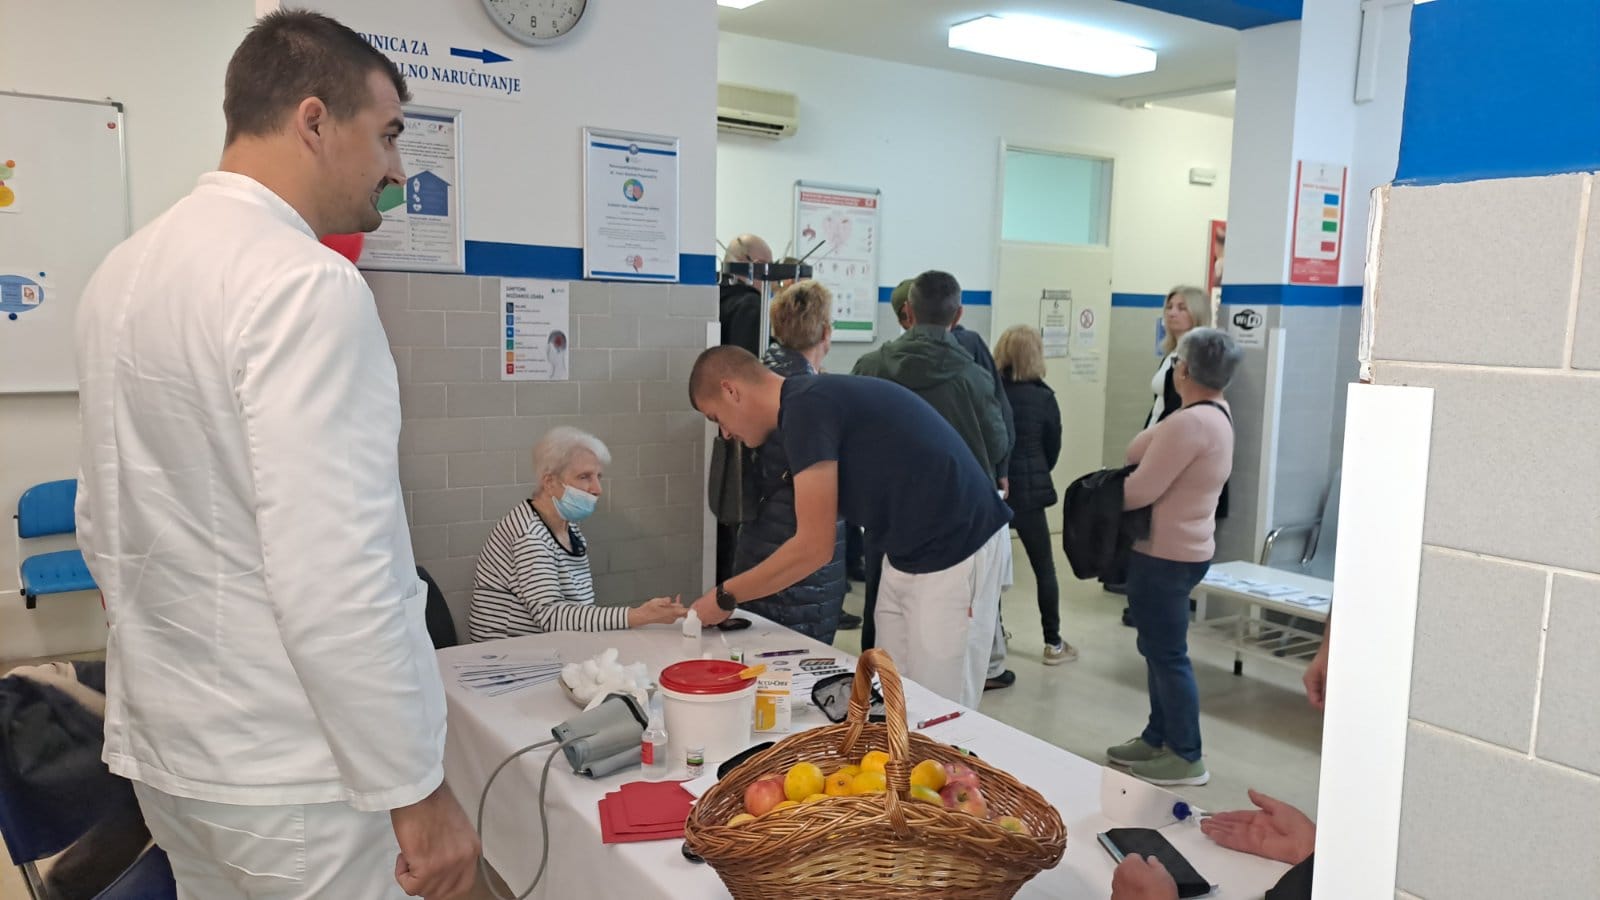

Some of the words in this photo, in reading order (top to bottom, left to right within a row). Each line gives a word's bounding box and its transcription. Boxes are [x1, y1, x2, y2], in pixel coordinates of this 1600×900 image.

[356, 32, 408, 52] DINICA
[411, 40, 429, 56] ZA
[400, 62, 429, 79] LNO
[431, 66, 521, 95] NARUČIVANJE
